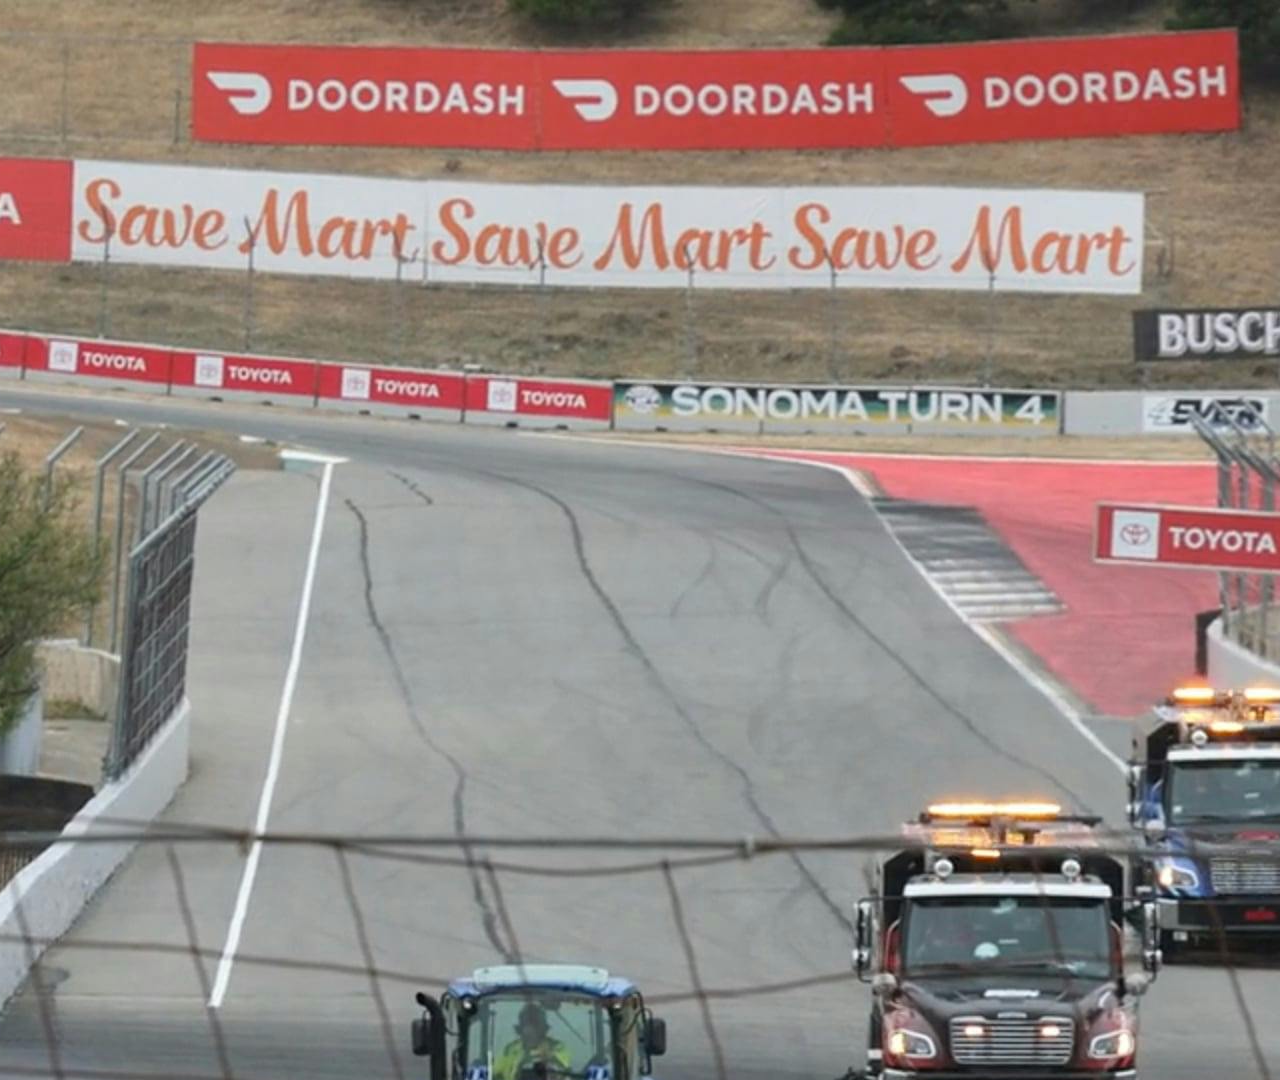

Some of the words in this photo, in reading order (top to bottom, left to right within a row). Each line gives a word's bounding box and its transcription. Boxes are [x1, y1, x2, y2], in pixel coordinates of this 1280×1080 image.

[288, 79, 525, 116] DOORDASH
[634, 82, 874, 116] DOORDASH
[984, 65, 1227, 108] DOORDASH
[78, 178, 228, 249] Save
[237, 188, 421, 263] Mart
[430, 198, 583, 269] Save
[593, 202, 776, 273] Mart
[787, 203, 942, 271] Save
[950, 205, 1138, 276] Mart
[83, 351, 147, 372] TOYOTA
[228, 365, 293, 385] TOYOTA
[375, 378, 440, 398] TOYOTA
[521, 391, 587, 409] TOYOTA
[671, 387, 869, 421] SONOMA
[878, 391, 1003, 424] TURN
[1015, 395, 1045, 425] 4
[1167, 525, 1277, 555] TOYOTA
